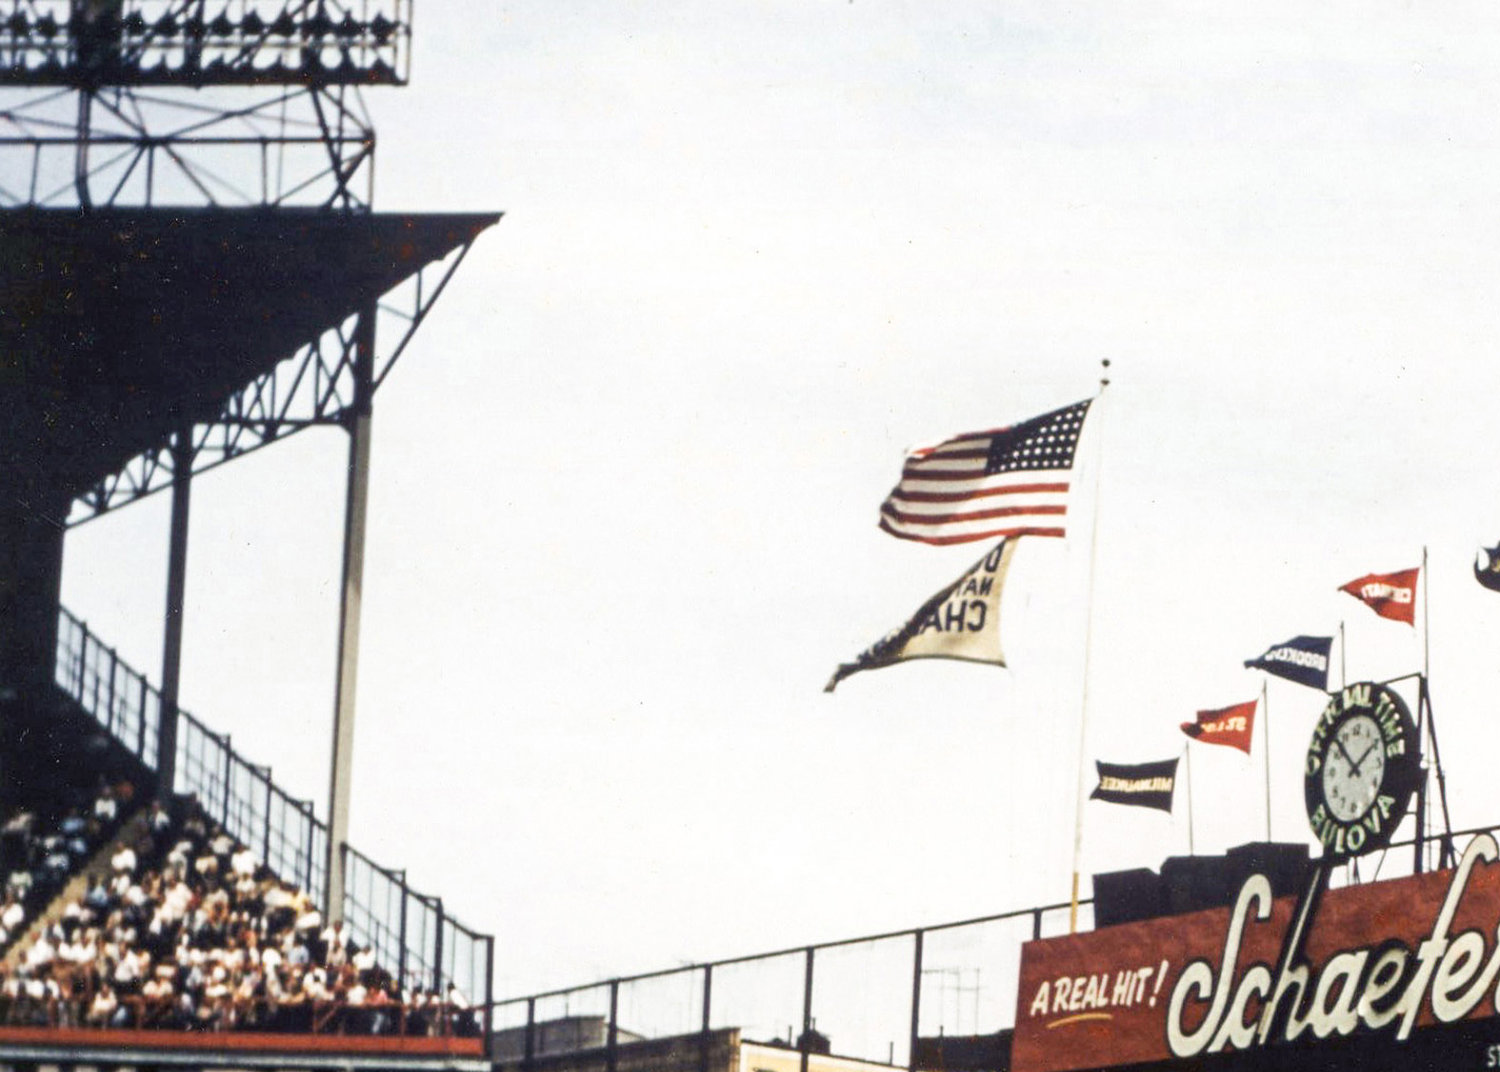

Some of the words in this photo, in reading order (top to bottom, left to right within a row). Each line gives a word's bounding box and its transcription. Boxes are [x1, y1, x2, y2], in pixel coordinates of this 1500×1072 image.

[1030, 981, 1050, 1016] A
[1052, 974, 1109, 1013] REAL
[1112, 959, 1169, 1007] HIT!
